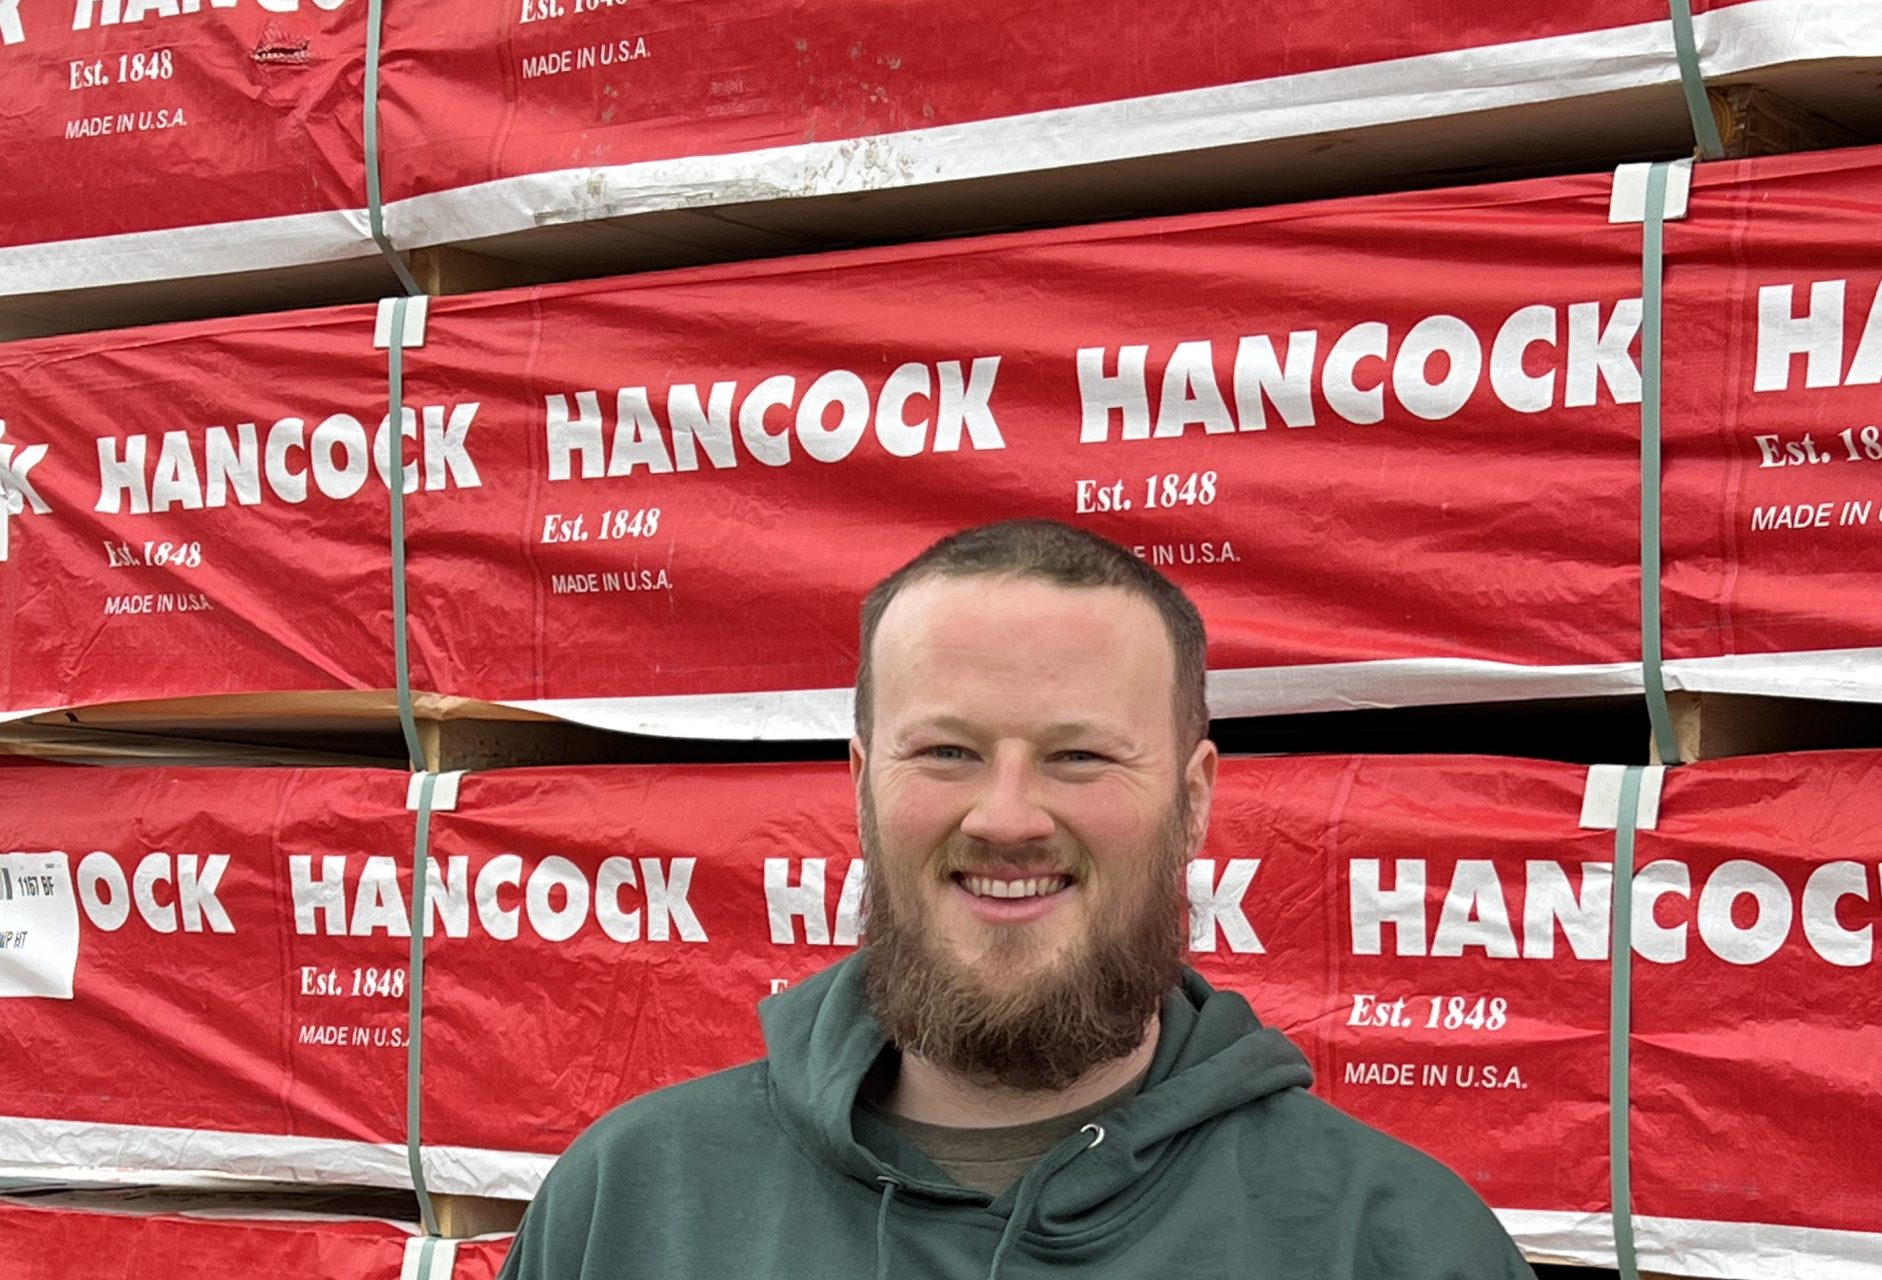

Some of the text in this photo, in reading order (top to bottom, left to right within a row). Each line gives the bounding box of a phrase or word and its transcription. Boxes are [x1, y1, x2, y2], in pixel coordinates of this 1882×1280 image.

[69, 49, 173, 90] Est. 1848
[522, 37, 651, 79] MADE IN U.S.A.
[65, 107, 188, 139] MADE IN U.S.A.
[1076, 297, 1642, 443] HANCOCK
[544, 356, 1006, 481] HANCOCK
[94, 402, 482, 514] HANCOCK
[1753, 433, 1831, 468] Est.
[1075, 470, 1217, 514] Est. 1848
[541, 508, 661, 544] Est. 1848
[1750, 502, 1834, 532] MADE
[1839, 500, 1872, 526] IN
[103, 540, 202, 569] Est. 1848
[1152, 544, 1174, 565] IN
[1180, 541, 1241, 564] U.S.A.
[551, 569, 673, 594] MADE IN U.S.A.
[104, 594, 154, 615] MADE
[156, 593, 174, 612] IN
[288, 853, 709, 943] HANCOCK
[1349, 858, 1882, 967] HANCOC
[301, 966, 405, 998] Est. 1848
[1346, 994, 1507, 1031] Est. 1848
[299, 1025, 349, 1045] MADE
[352, 1026, 370, 1046] IN
[1344, 1062, 1528, 1089] MADE IN U.S.A.
